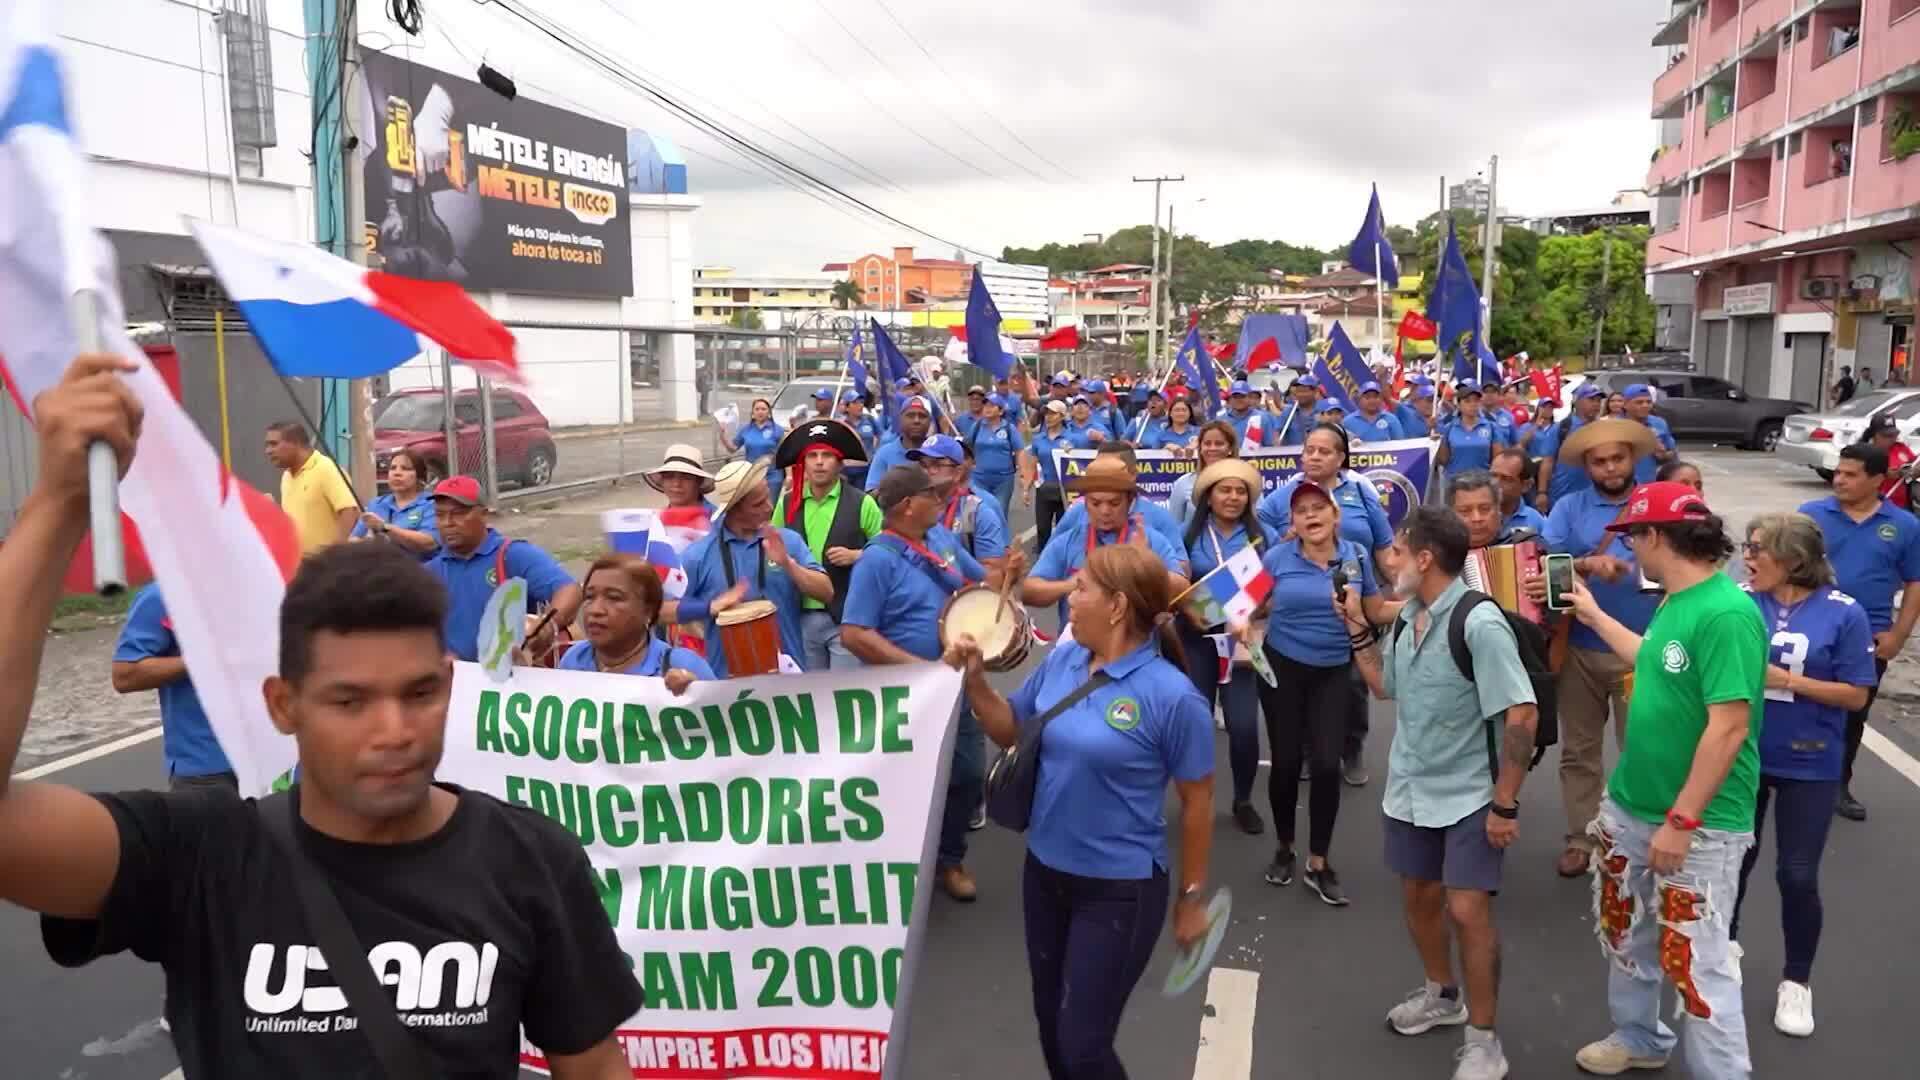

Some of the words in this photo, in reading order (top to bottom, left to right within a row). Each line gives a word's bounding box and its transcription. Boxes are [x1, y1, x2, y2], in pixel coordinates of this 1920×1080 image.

[467, 122, 549, 171] MÉTELE
[553, 146, 625, 188] ENERGÍA
[478, 163, 561, 208] MÉTELE
[512, 240, 545, 258] ahora
[547, 244, 560, 260] te
[561, 246, 584, 262] toca
[586, 251, 593, 263] a
[593, 249, 602, 265] ti
[525, 227, 535, 238] de
[1156, 461, 1196, 474] JUBIL
[1248, 457, 1296, 471] DIGNA
[1349, 453, 1398, 467] ECIDA:
[476, 688, 819, 764] ASOCIACIÓN
[833, 686, 914, 754] DE
[636, 862, 920, 931] MIGUELIT
[624, 950, 738, 1010] AM
[245, 1014, 331, 1033] Unlimited
[397, 1007, 488, 1028] ternational
[617, 1035, 718, 1070] MPRE
[723, 1035, 749, 1069] A
[751, 1032, 815, 1069] LOS
[819, 1033, 888, 1073] MEJ
